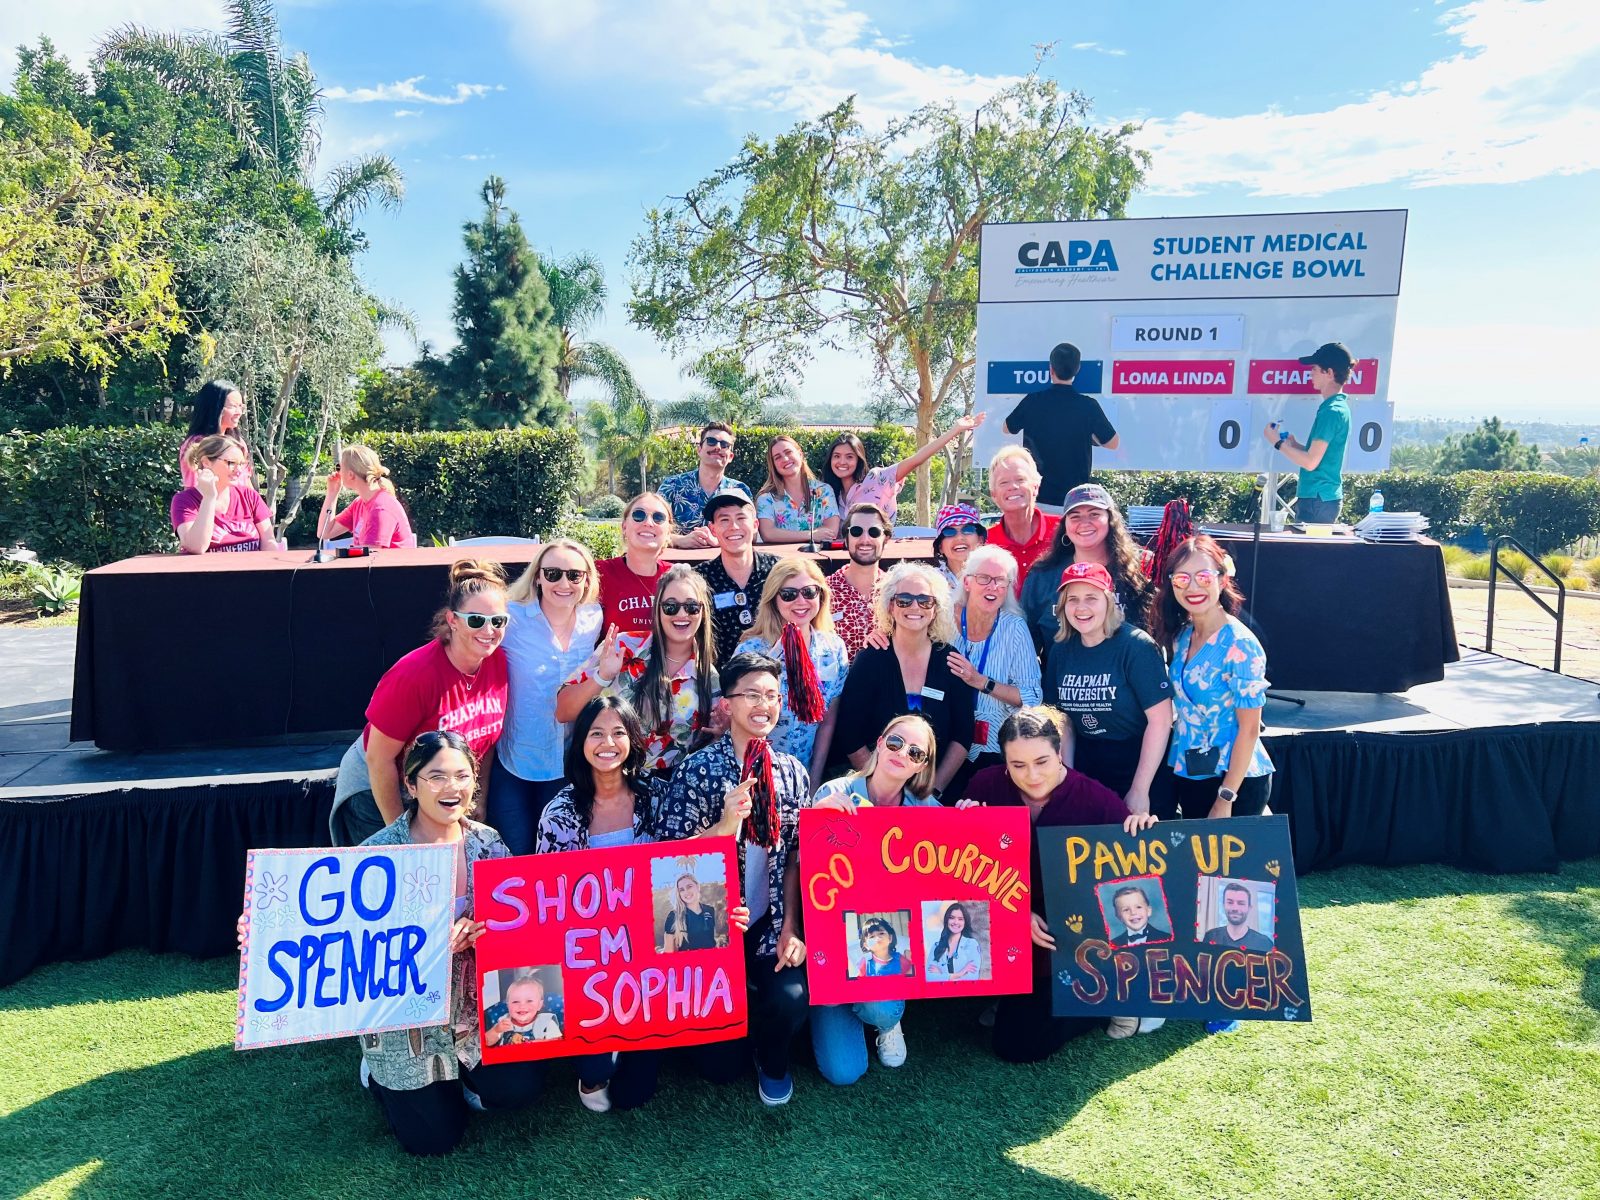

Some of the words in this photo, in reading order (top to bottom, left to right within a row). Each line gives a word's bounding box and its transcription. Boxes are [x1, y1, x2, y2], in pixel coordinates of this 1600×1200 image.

[1018, 239, 1119, 271] CAPA
[1152, 235, 1256, 256] STUDENT
[1261, 231, 1368, 253] MEDICAL
[1150, 261, 1284, 282] CHALLENGE
[1292, 259, 1366, 279] BOWL
[1135, 327, 1203, 342] ROUND
[1209, 327, 1218, 341] 1
[1013, 370, 1075, 384] TOU
[1119, 372, 1169, 385] LOMA
[1173, 371, 1226, 385] LINDA
[1262, 370, 1363, 385] CHAPN
[1218, 419, 1241, 450] 0
[1358, 421, 1383, 453] 0
[1062, 674, 1111, 687] CHAPMAN
[438, 697, 503, 732] CHAPMAN
[881, 826, 1030, 913] COURTNIE
[1066, 836, 1168, 884] PAWS
[1190, 834, 1246, 876] UP
[298, 855, 397, 927] GO
[485, 866, 634, 931] SHOW
[808, 853, 854, 911] GO
[564, 923, 633, 969] EM
[254, 924, 427, 1013] SPENCER
[1072, 938, 1306, 1012] SPENCER
[578, 966, 734, 1028] SOPHIA
